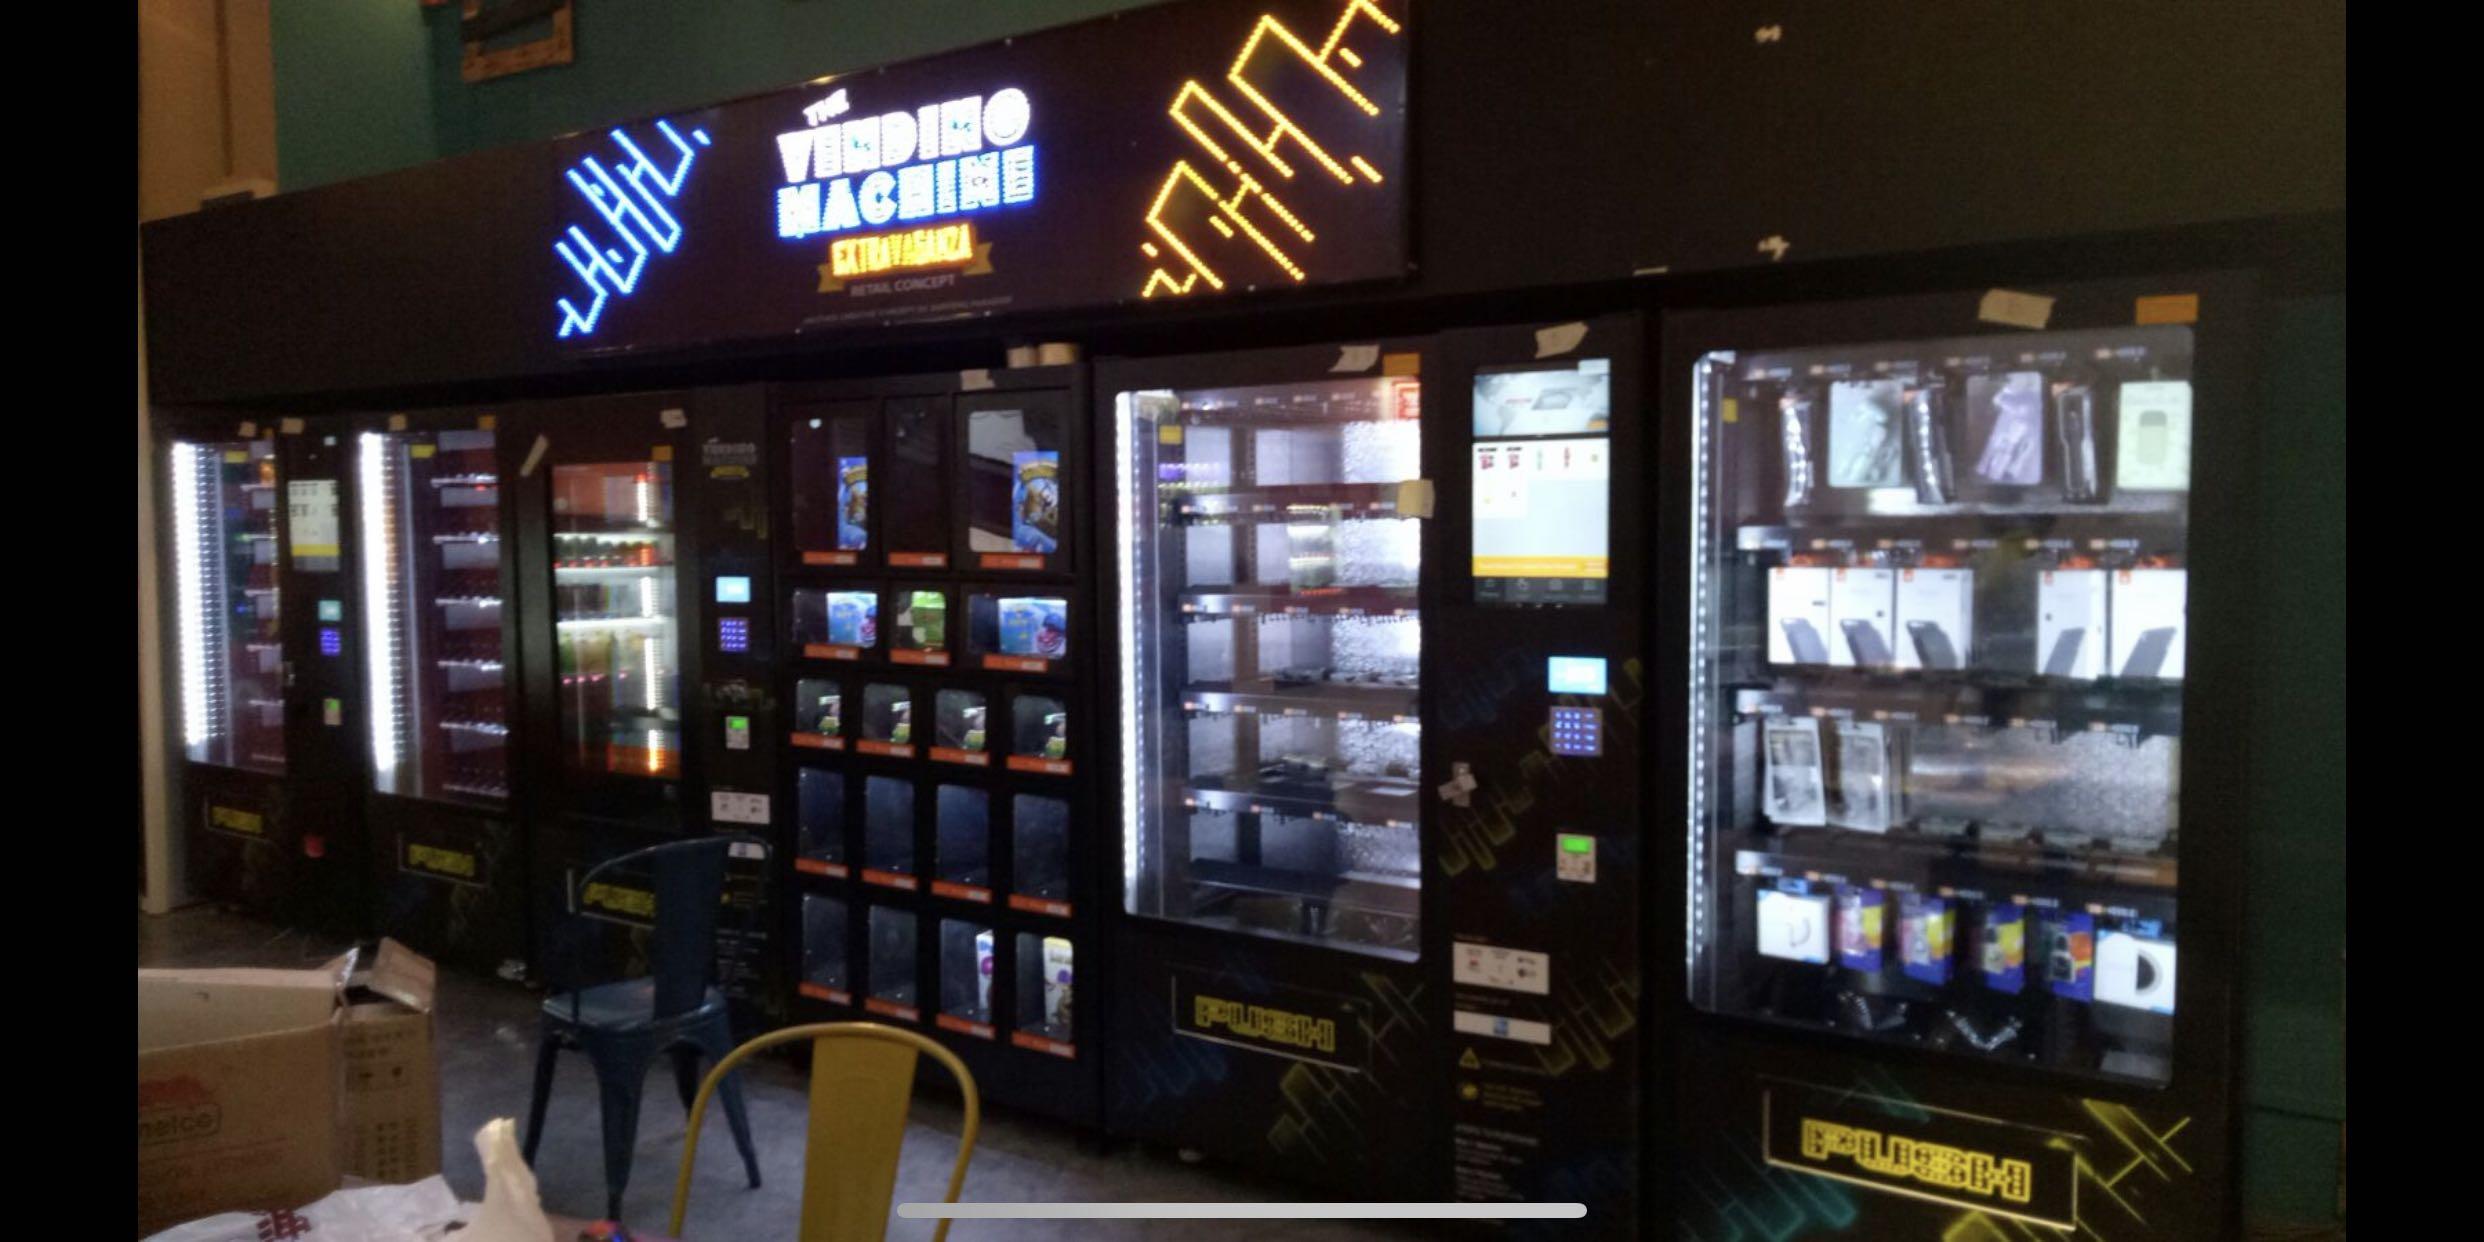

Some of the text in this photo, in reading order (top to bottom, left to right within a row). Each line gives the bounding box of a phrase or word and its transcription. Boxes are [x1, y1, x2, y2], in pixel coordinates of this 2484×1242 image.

[803, 88, 850, 126] THE
[777, 145, 1035, 237] MACHINE
[831, 223, 974, 277] EXTRAVAGANZA
[894, 274, 956, 292] CONCEPT
[1194, 994, 1337, 1053] PUSH
[1802, 1117, 2032, 1204] PUSH
